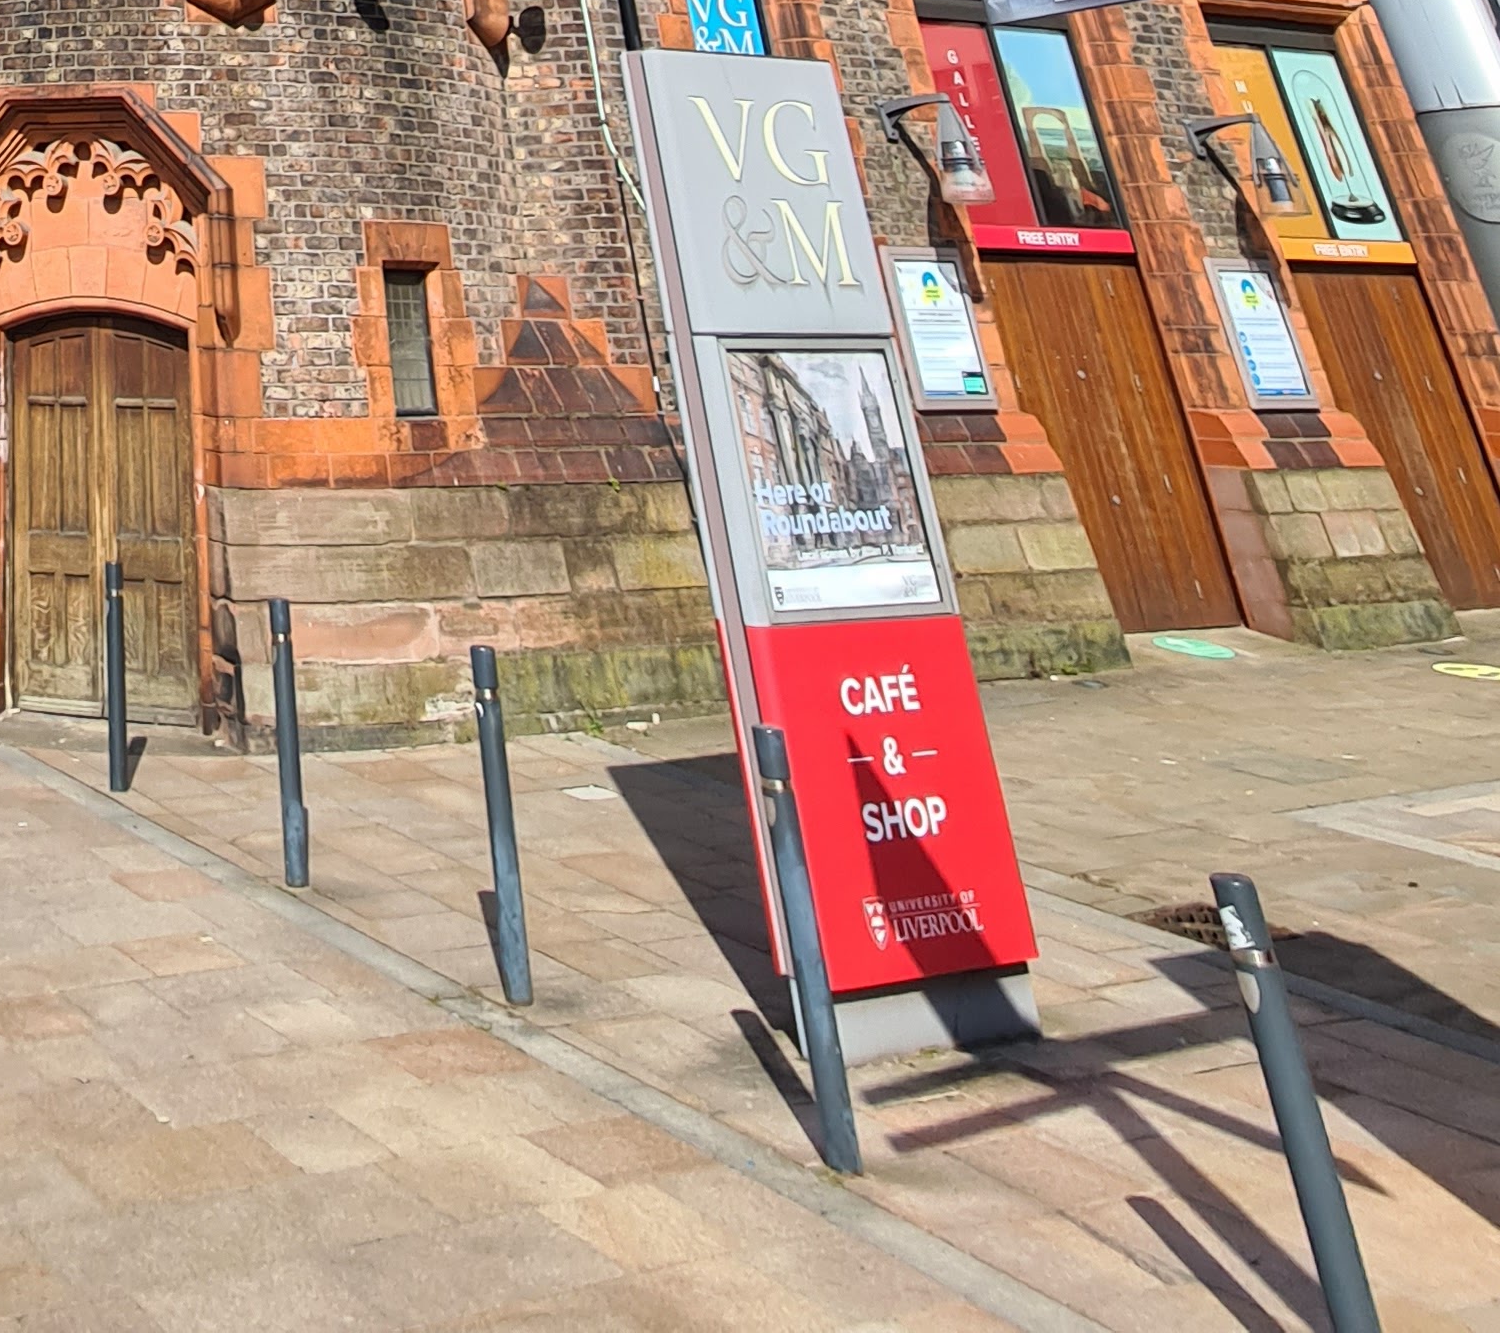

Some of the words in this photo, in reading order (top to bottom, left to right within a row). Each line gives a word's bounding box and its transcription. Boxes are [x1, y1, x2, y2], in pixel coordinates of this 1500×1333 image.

[687, 95, 830, 187] VG
[721, 194, 861, 286] &M
[1017, 230, 1046, 245] FREE
[1045, 231, 1080, 246] ENTRY
[1313, 243, 1340, 257] FREE
[1338, 244, 1369, 257] ENTRY
[754, 478, 807, 506] Here
[762, 504, 893, 537] Roundabout
[840, 664, 921, 715] CAFÉ
[882, 736, 907, 775] &
[862, 796, 947, 842] SHOP
[888, 893, 956, 913] UNIVERSITY
[959, 889, 975, 903] OF
[892, 908, 985, 942] LIVERPOOL
